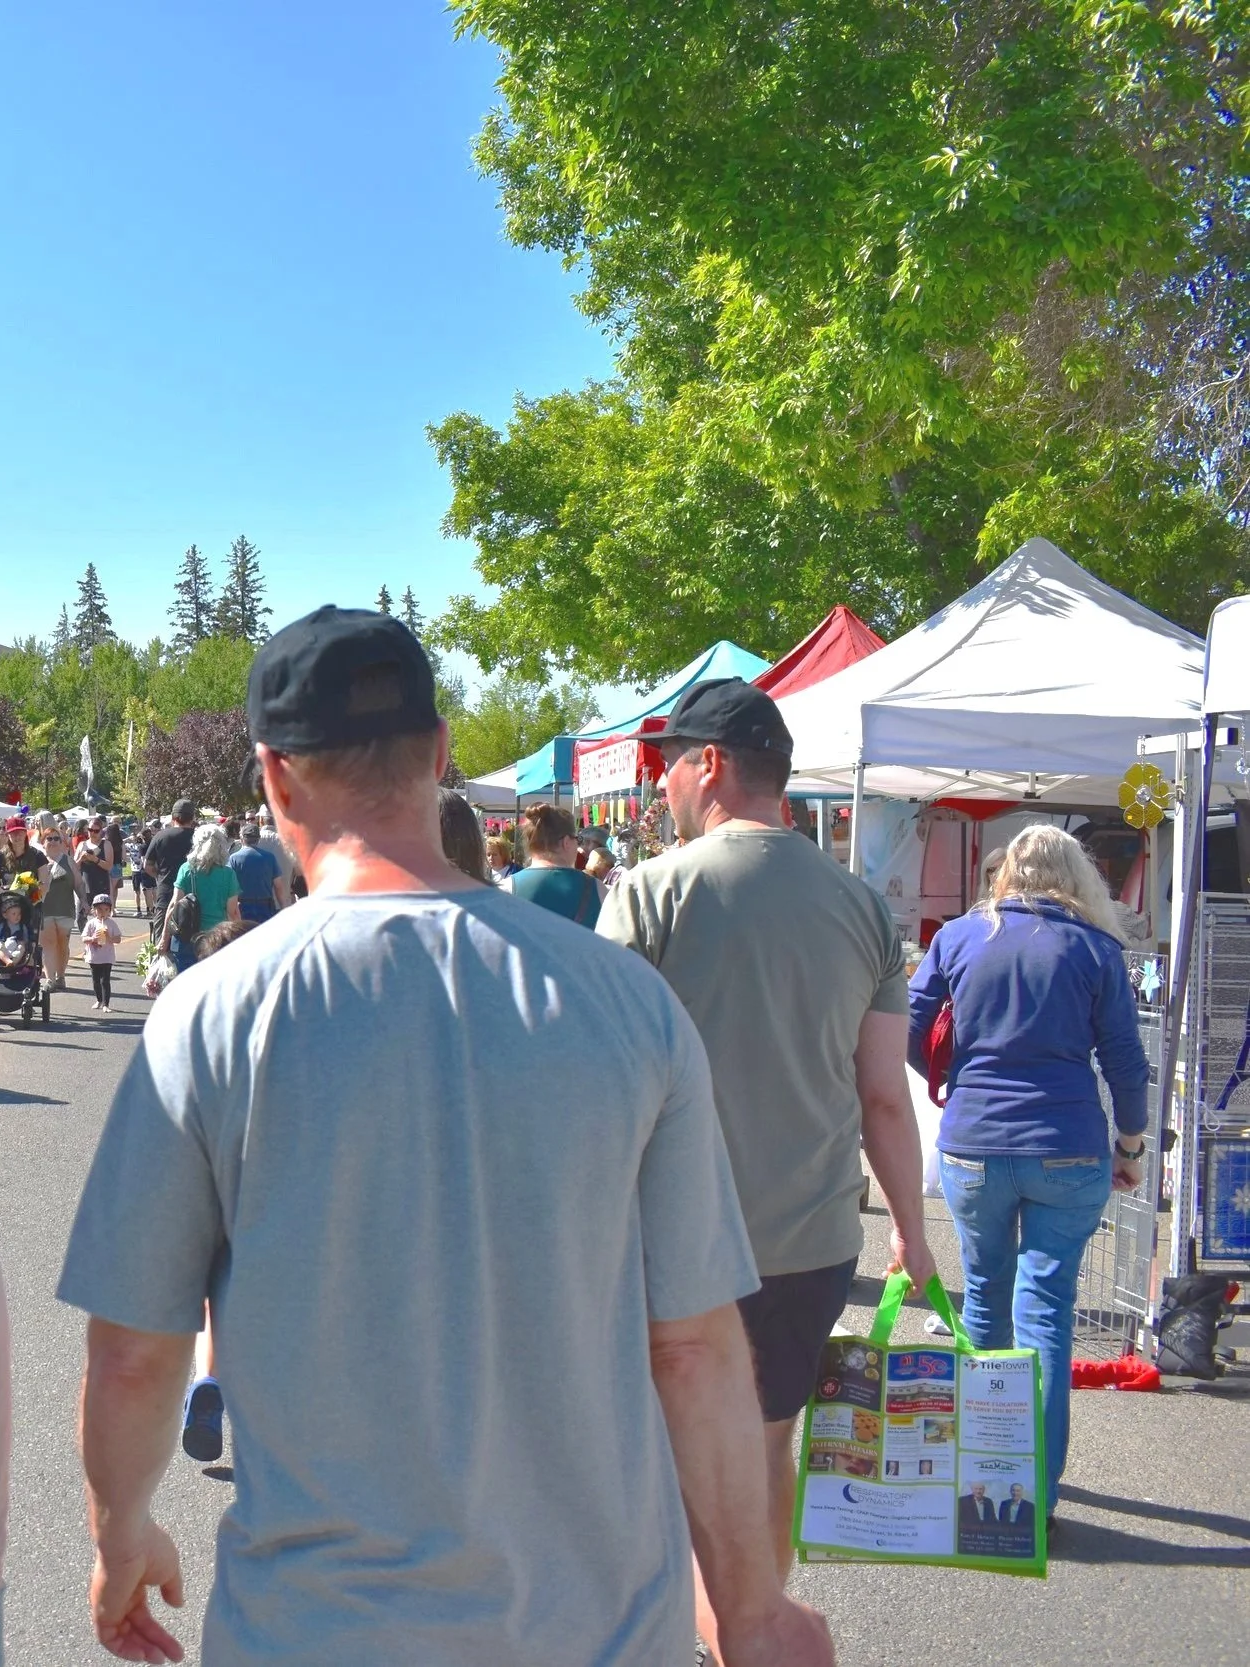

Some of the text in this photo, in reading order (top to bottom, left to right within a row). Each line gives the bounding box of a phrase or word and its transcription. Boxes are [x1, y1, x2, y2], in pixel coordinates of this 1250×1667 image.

[980, 1361, 1029, 1370] TileTown
[990, 1379, 1004, 1390] 50
[850, 1485, 914, 1501] RESPIRATORY
[857, 1494, 905, 1508] DYNAMICS
